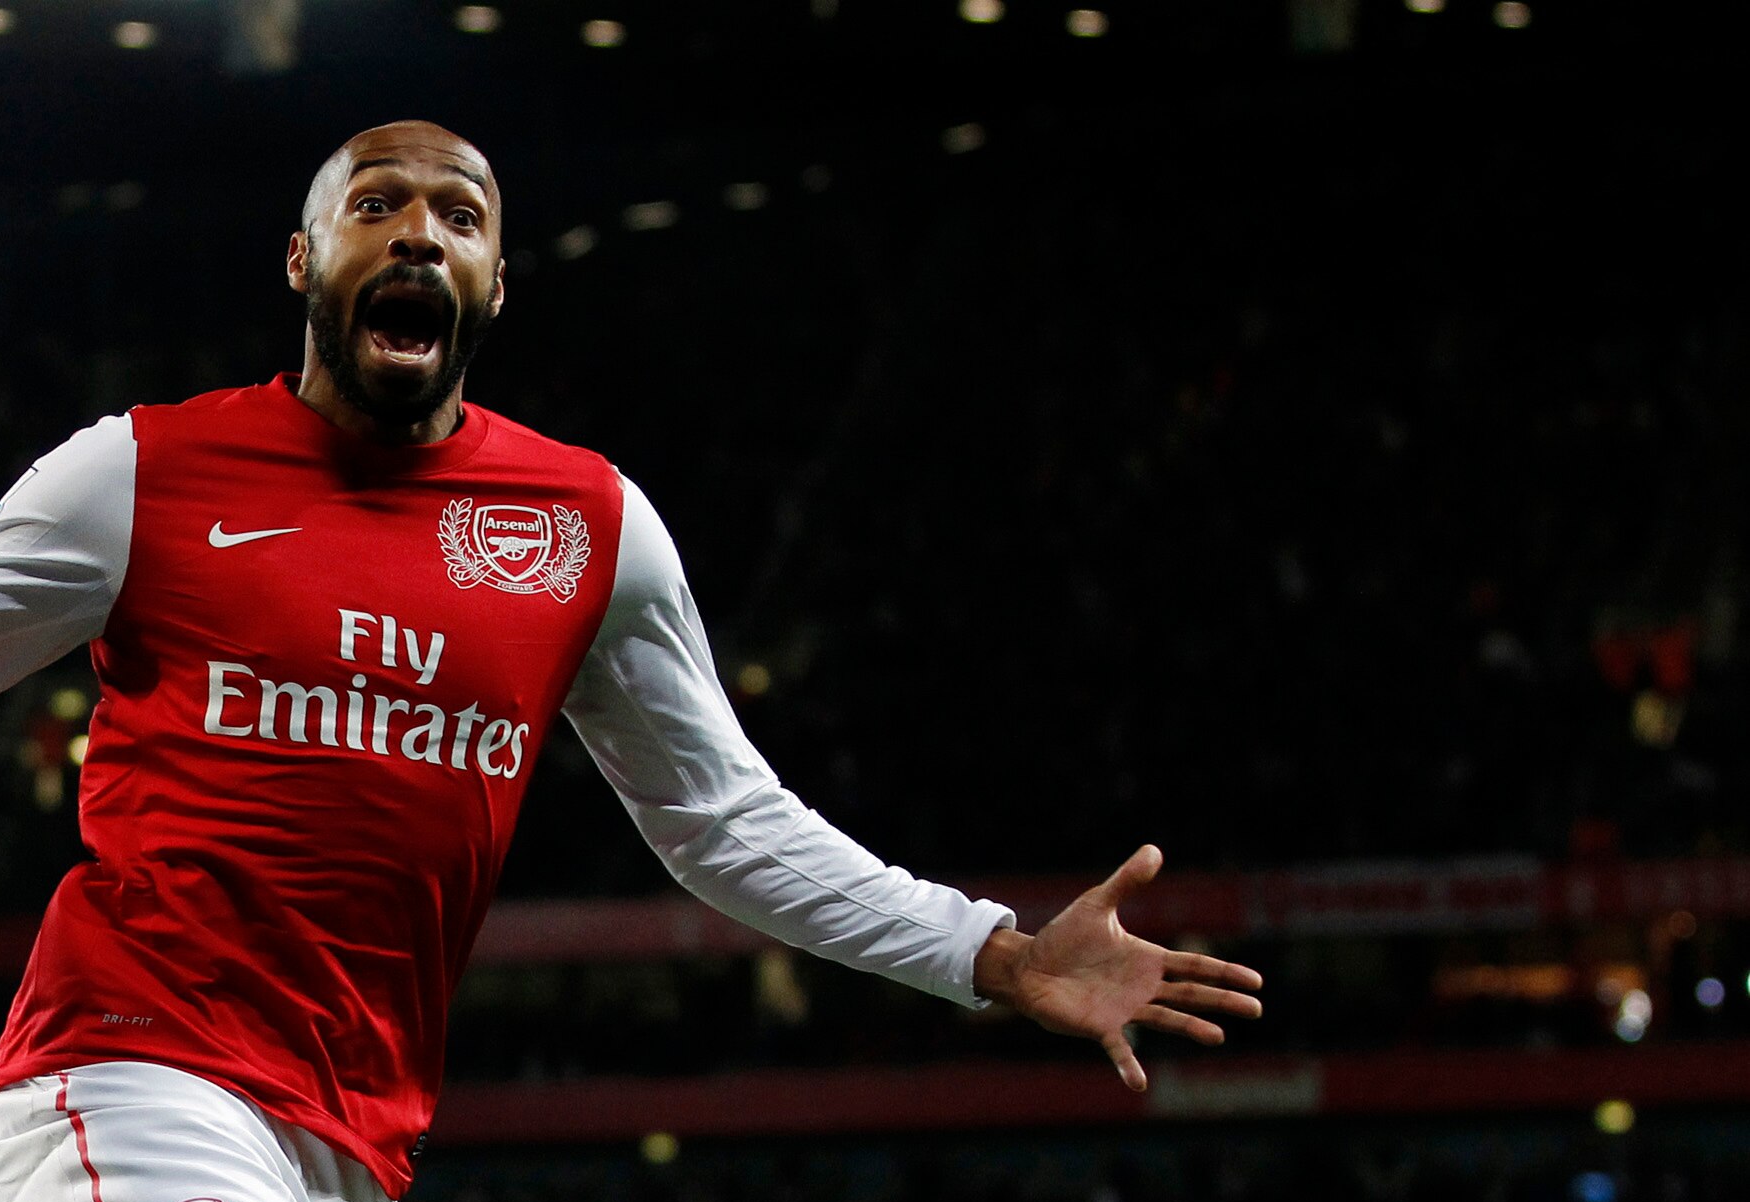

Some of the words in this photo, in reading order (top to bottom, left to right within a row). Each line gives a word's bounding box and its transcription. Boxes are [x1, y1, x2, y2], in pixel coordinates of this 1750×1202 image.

[485, 517, 540, 532] Arsenal
[337, 607, 446, 685] Fly
[203, 659, 530, 780] Emirates
[102, 1013, 154, 1028] DRI-FIT
